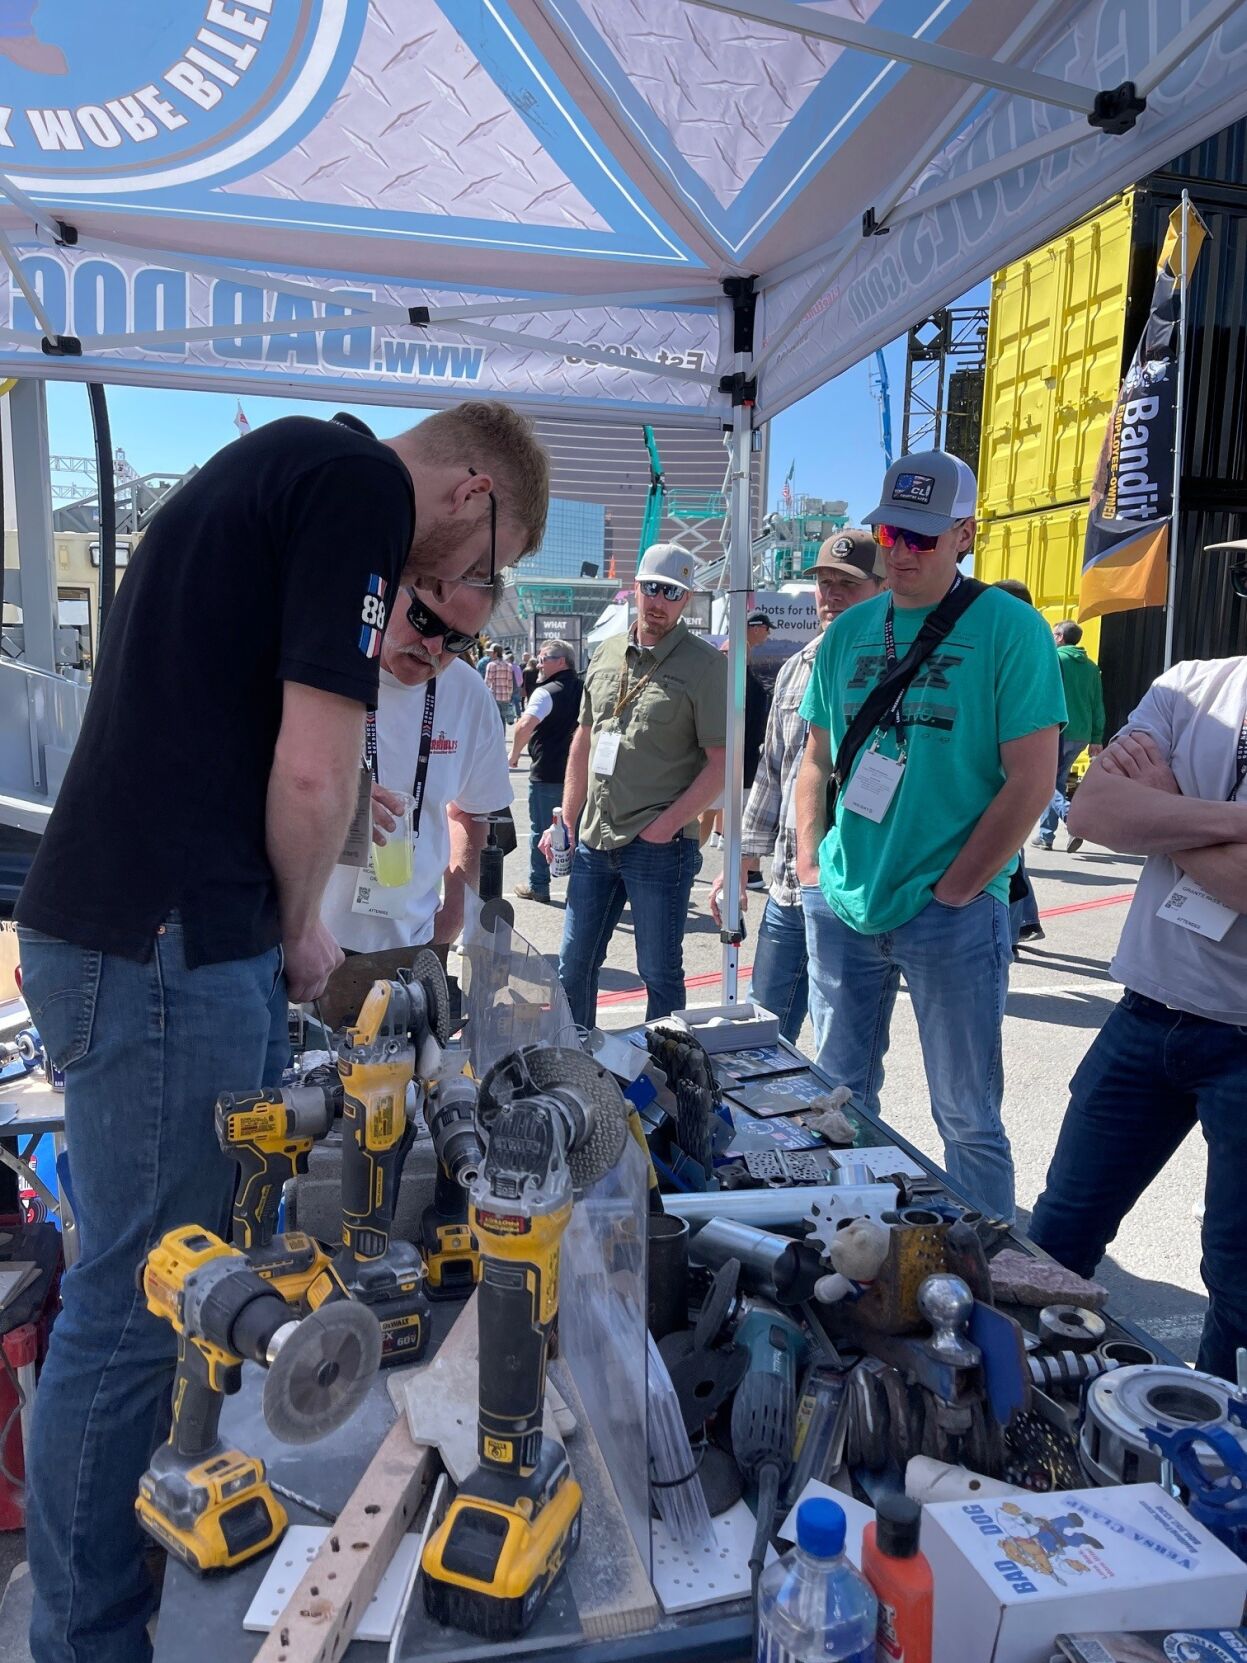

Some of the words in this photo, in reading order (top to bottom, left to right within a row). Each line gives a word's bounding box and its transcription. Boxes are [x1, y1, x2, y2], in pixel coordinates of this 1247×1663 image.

[1101, 403, 1127, 521] EMPLOYEE-OWNED
[1116, 395, 1160, 521] Bandit
[361, 594, 386, 630] 88
[543, 620, 568, 629] WHAT
[788, 604, 803, 615] for
[806, 604, 817, 615] th
[543, 631, 561, 639] YOU
[962, 1504, 1004, 1536] DOG
[1065, 1500, 1126, 1534] CLAMP
[994, 1559, 1039, 1594] BAD
